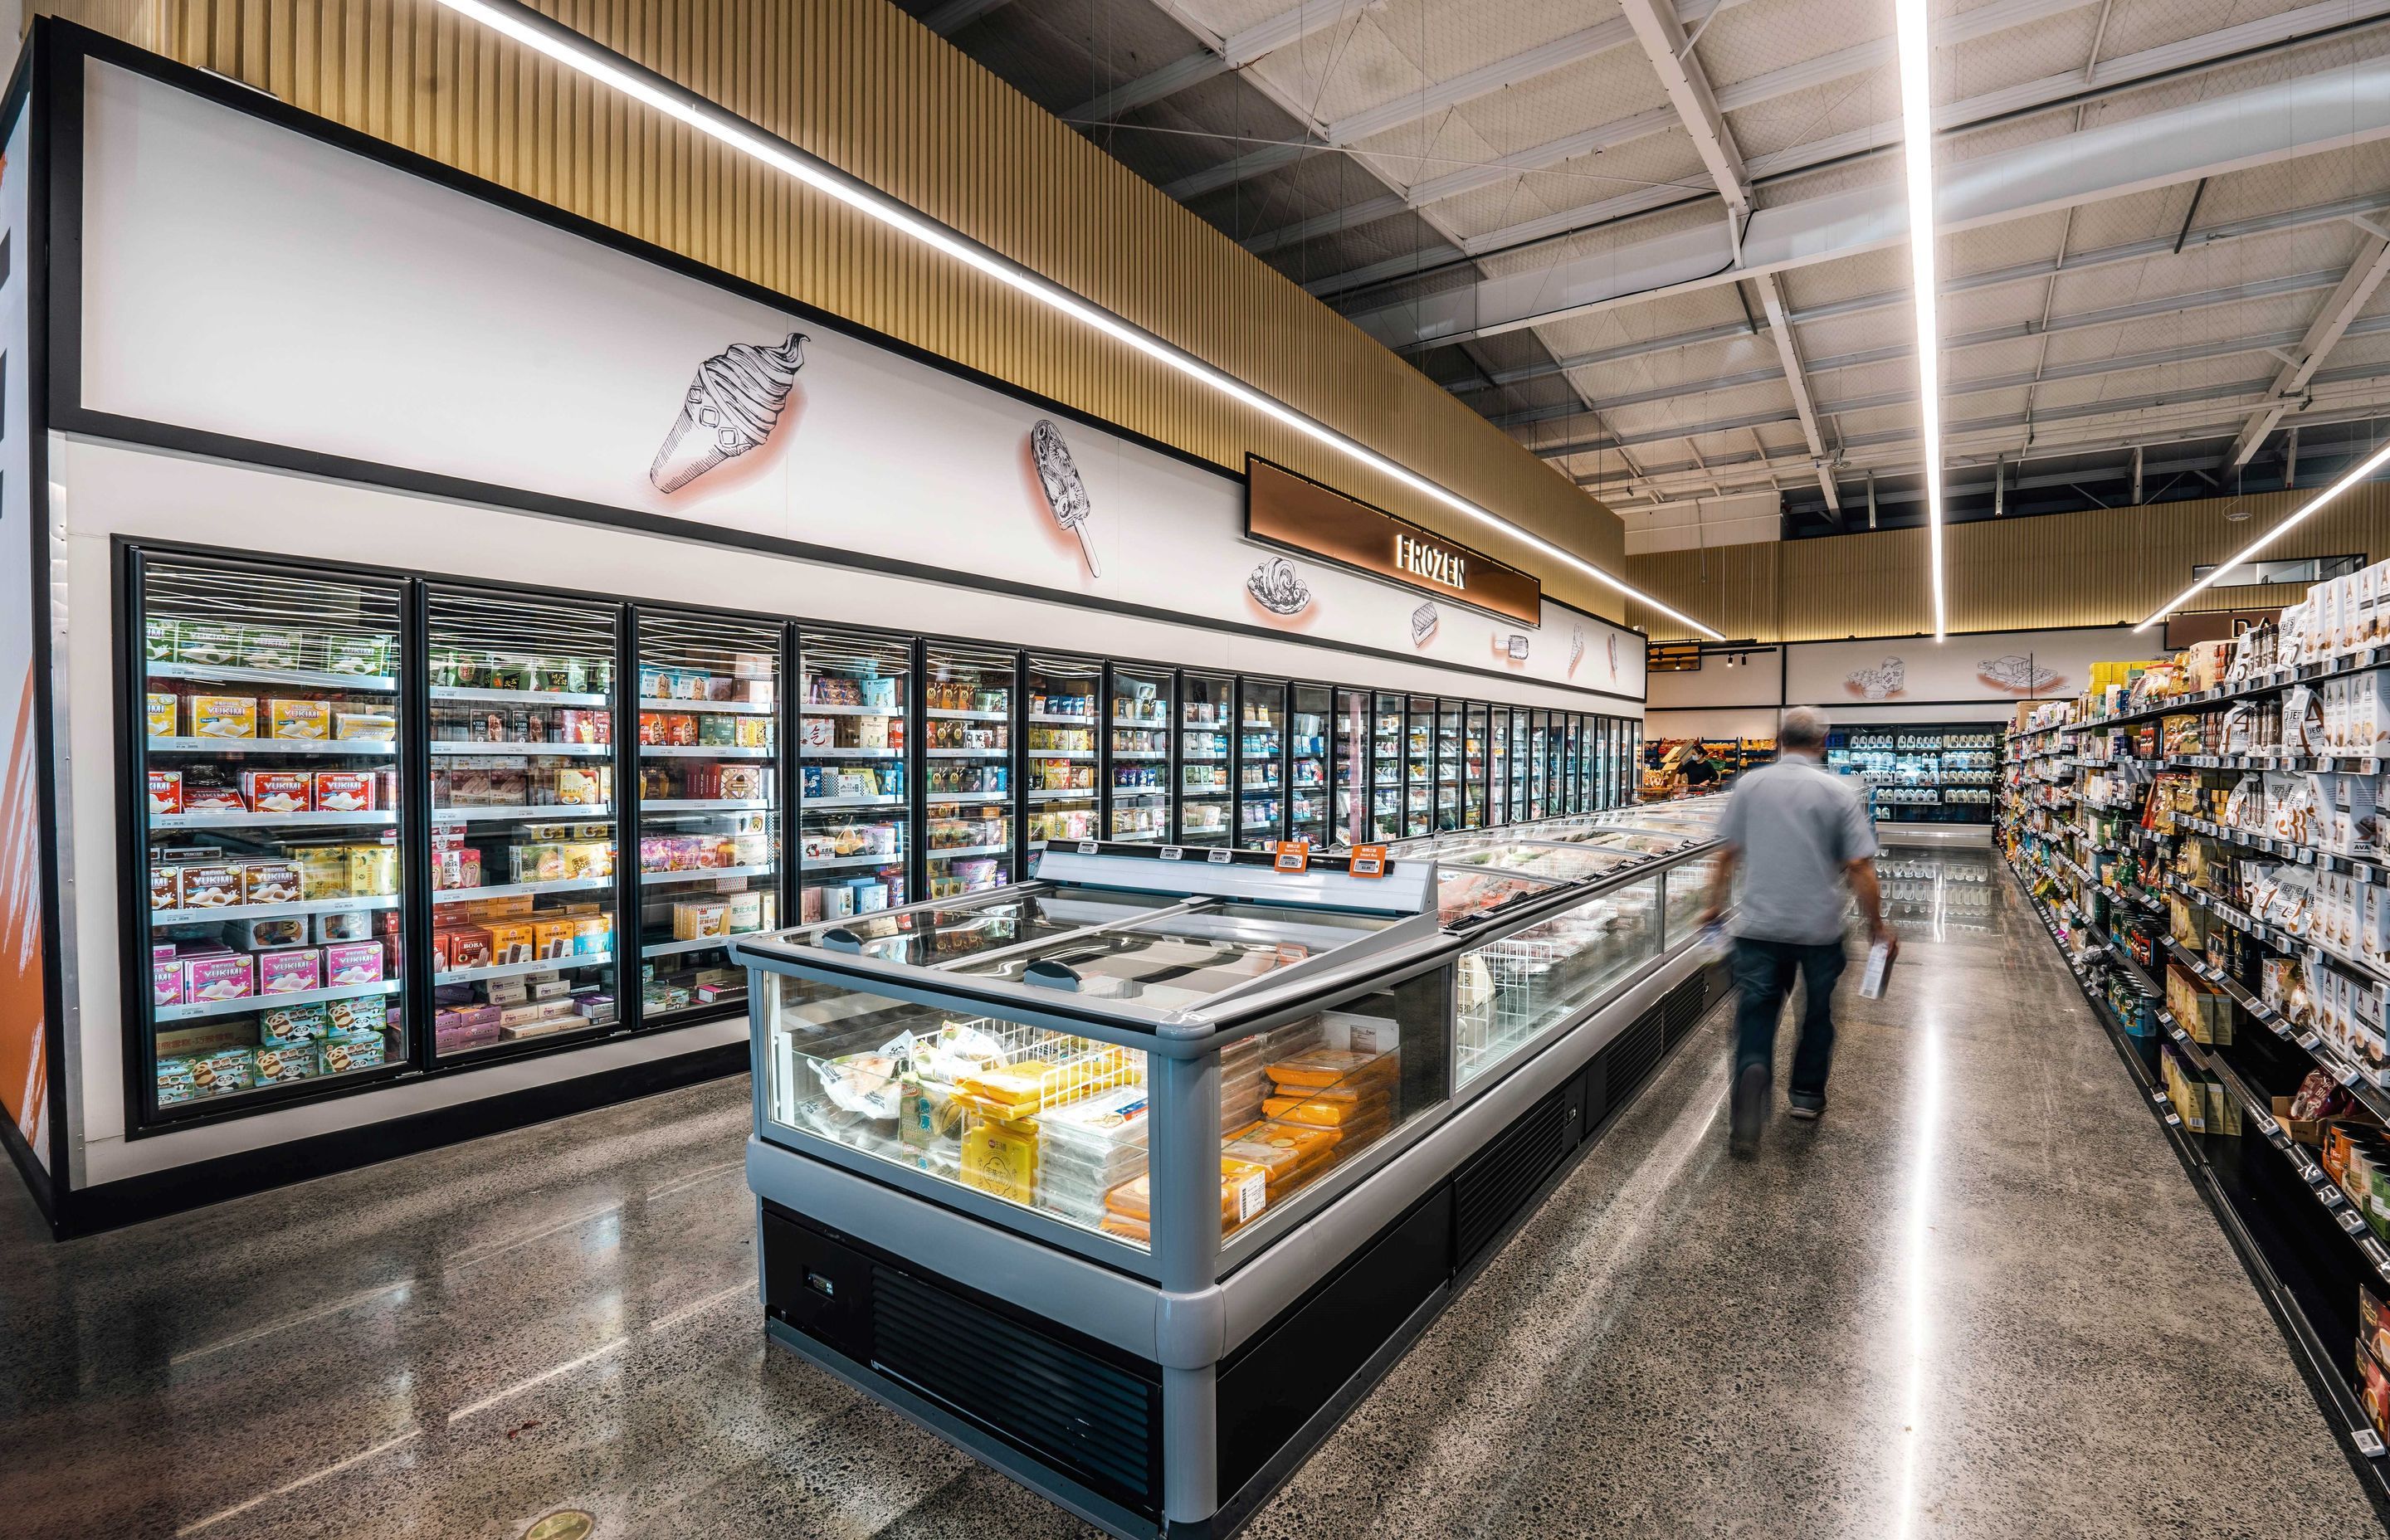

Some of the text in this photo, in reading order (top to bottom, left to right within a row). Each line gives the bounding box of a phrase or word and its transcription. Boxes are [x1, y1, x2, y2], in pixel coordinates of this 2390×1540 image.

[1397, 534, 1466, 589] FROZEN
[207, 706, 246, 715] YUKIMI
[285, 709, 321, 718] YUKIMI
[264, 782, 301, 790] YUKIMI
[327, 782, 362, 790] YUKIMI
[193, 875, 234, 885] YUKIMI
[256, 872, 293, 881] YUKIMI
[339, 955, 373, 964] YUKIMI
[274, 961, 309, 971] YUKIMI
[204, 967, 242, 978] YUKIMI
